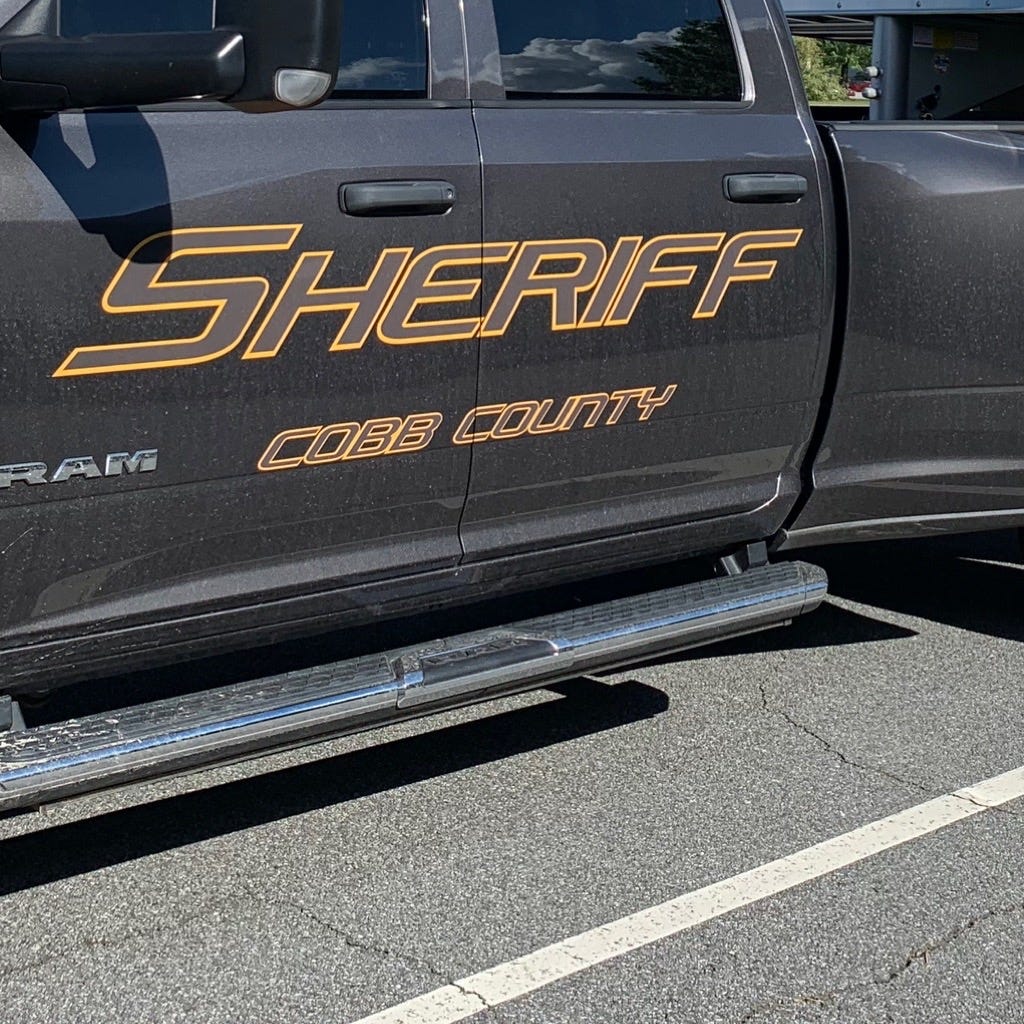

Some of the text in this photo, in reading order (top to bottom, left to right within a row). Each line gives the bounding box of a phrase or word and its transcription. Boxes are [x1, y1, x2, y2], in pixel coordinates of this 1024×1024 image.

[52, 223, 803, 378] SHERIFF
[0, 448, 158, 489] RAM
[257, 384, 678, 472] COBB COUNTY
